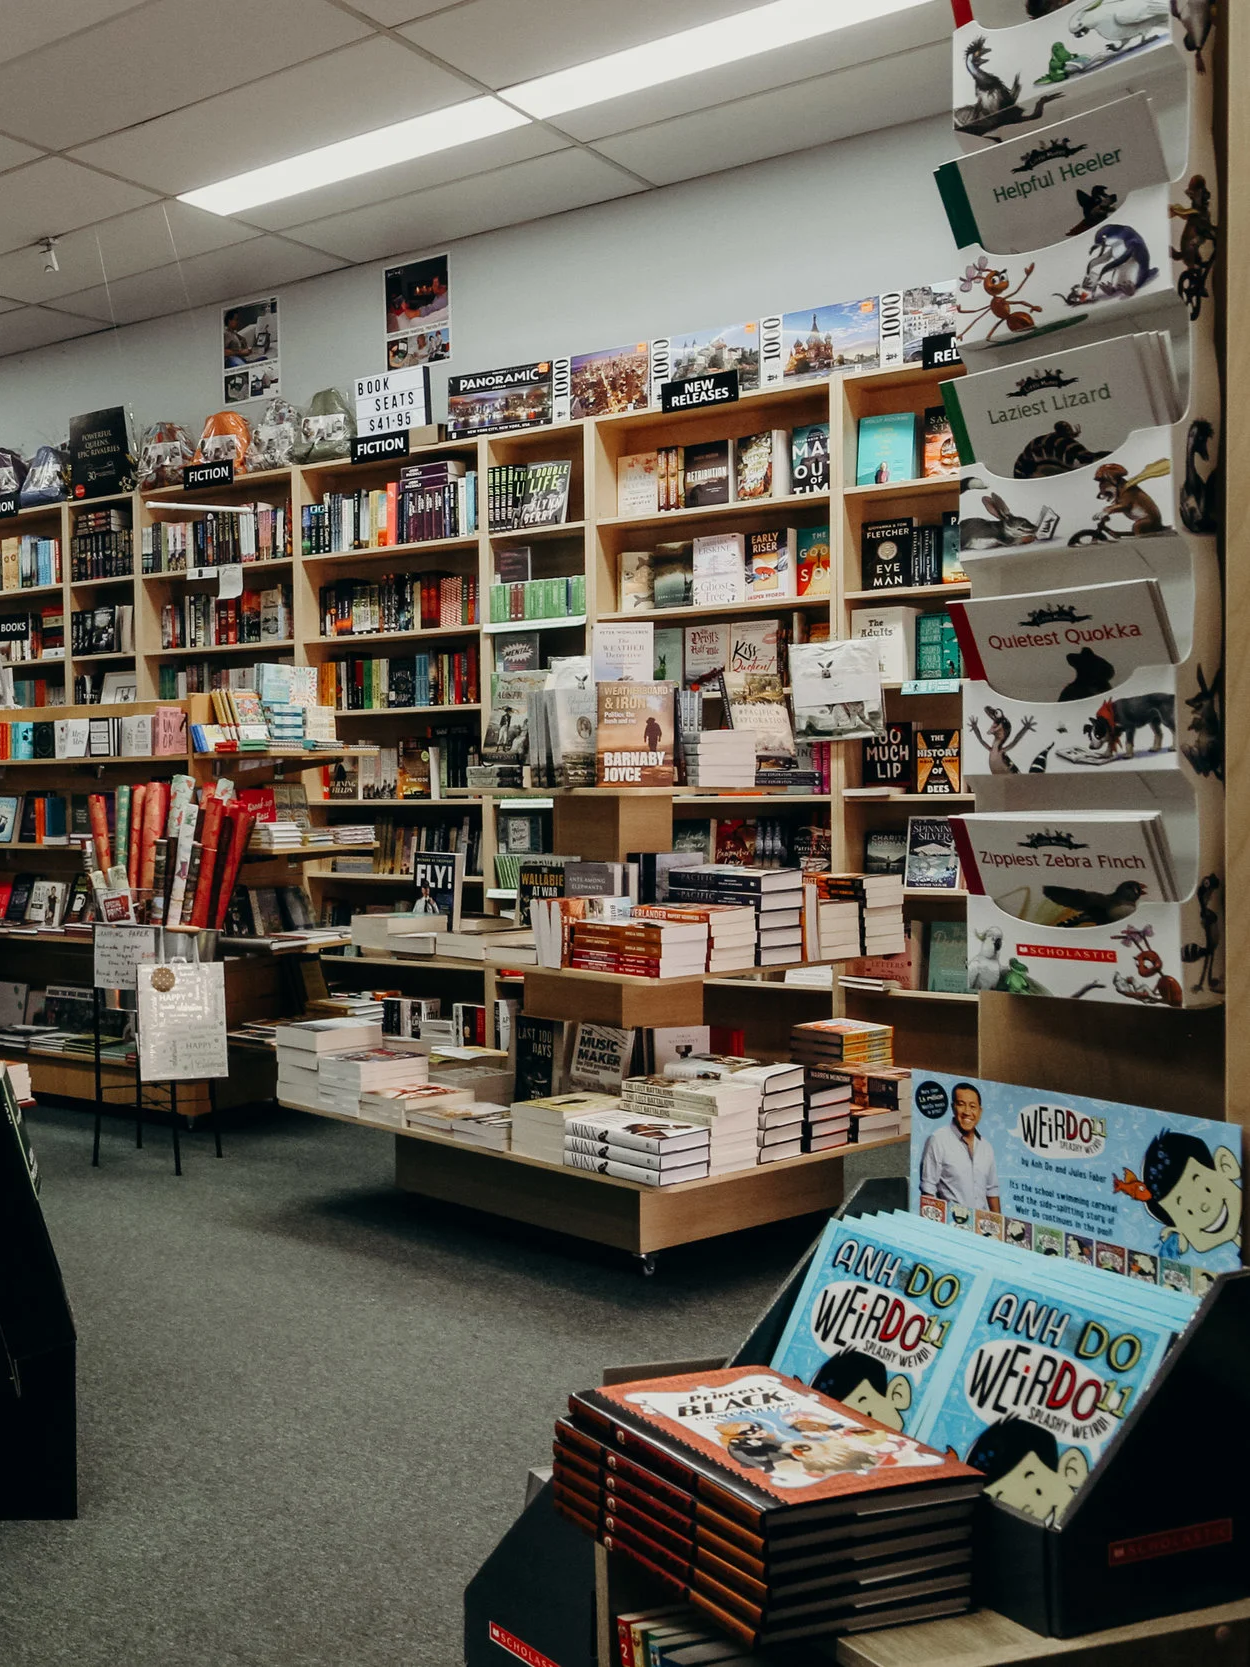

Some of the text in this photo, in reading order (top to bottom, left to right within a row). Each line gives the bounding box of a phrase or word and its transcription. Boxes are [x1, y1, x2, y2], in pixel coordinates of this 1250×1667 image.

[993, 148, 1122, 203] Helpful Heeler
[881, 293, 901, 340] 1000
[762, 318, 781, 363] 1000
[652, 339, 670, 382] 1000
[358, 377, 390, 396] BOOK
[460, 369, 539, 391] PANORAMIC
[555, 359, 569, 399] 1000
[684, 379, 715, 394] NEW
[375, 392, 414, 411] SEATS
[671, 388, 729, 407] RELEASES
[988, 383, 1112, 425] Laziest Lizard
[357, 437, 404, 456] FICTION
[189, 465, 229, 482] FICTION
[535, 465, 568, 478] DOUBLE
[686, 466, 727, 482] RETRIBUTION
[528, 475, 559, 494] LIFE
[751, 532, 779, 546] EARLY
[866, 528, 910, 539] FLETCHER
[753, 542, 777, 553] RISER
[876, 563, 900, 573] EVE
[873, 576, 903, 587] MAN
[1, 621, 26, 632] BOOKS
[861, 628, 893, 638] Adults
[988, 623, 1142, 651] Quietest Quokka
[604, 686, 668, 696] WEATHERBOARD
[605, 697, 647, 709] & IRON
[603, 751, 665, 767] BARNABY
[866, 745, 909, 762] MUCH
[917, 749, 958, 757] HISTORY
[603, 767, 641, 782] JOYCE
[876, 762, 901, 779] LIP
[979, 851, 1146, 869] Zippiest Zebra Finch
[416, 865, 452, 889] FLY!
[532, 886, 558, 897] AT WAR
[1030, 946, 1115, 961] SCHOLASTIC
[581, 1028, 592, 1036] THE
[579, 1037, 619, 1053] MUSIC
[578, 1049, 621, 1066] MAKER
[1091, 1116, 1107, 1137] 11
[1021, 1157, 1107, 1184] by Anh Do and Jules Faber
[833, 1239, 961, 1309] ANH DO
[920, 1314, 952, 1350] 11
[989, 1293, 1142, 1373] ANH DO
[863, 1339, 930, 1370] SPLASHY WEIRD!
[678, 1391, 785, 1417] BLACK
[1097, 1379, 1135, 1420] 11
[1028, 1405, 1110, 1440] SPLASHY WEIRD!
